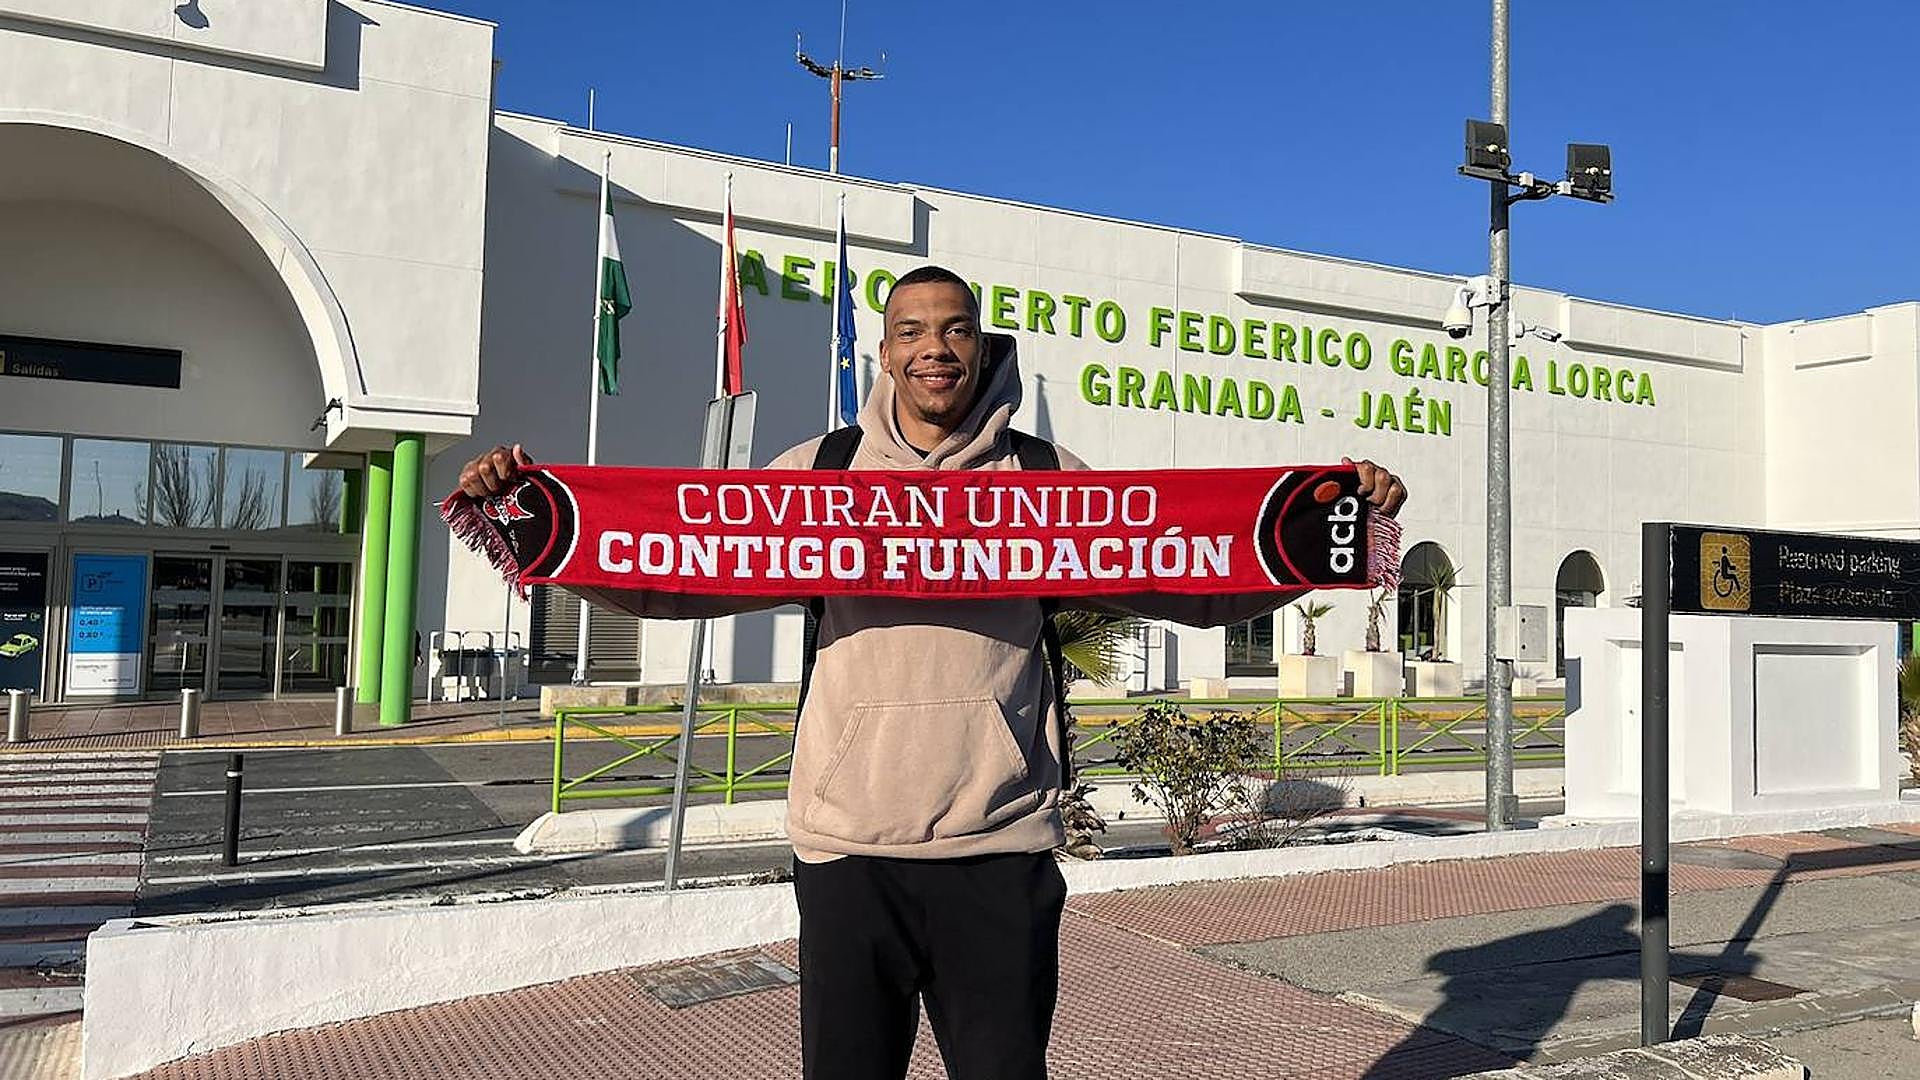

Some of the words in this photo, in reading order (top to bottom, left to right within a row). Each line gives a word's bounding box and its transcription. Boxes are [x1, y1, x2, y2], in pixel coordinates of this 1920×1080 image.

[741, 249, 1126, 344] AEROERTO
[1149, 306, 1373, 371] FEDERICO
[1389, 339, 1534, 391] GARCA
[1547, 360, 1656, 407] LORCA
[12, 363, 60, 377] Salidas
[1079, 363, 1304, 424] GRANADA
[1354, 387, 1452, 436] JAÉN
[677, 483, 949, 527] COVIRAN
[963, 485, 1158, 528] UNIDO
[1328, 496, 1359, 574] acb
[598, 530, 867, 580] CONTIGO
[882, 526, 1234, 581] FUNDACIÓN
